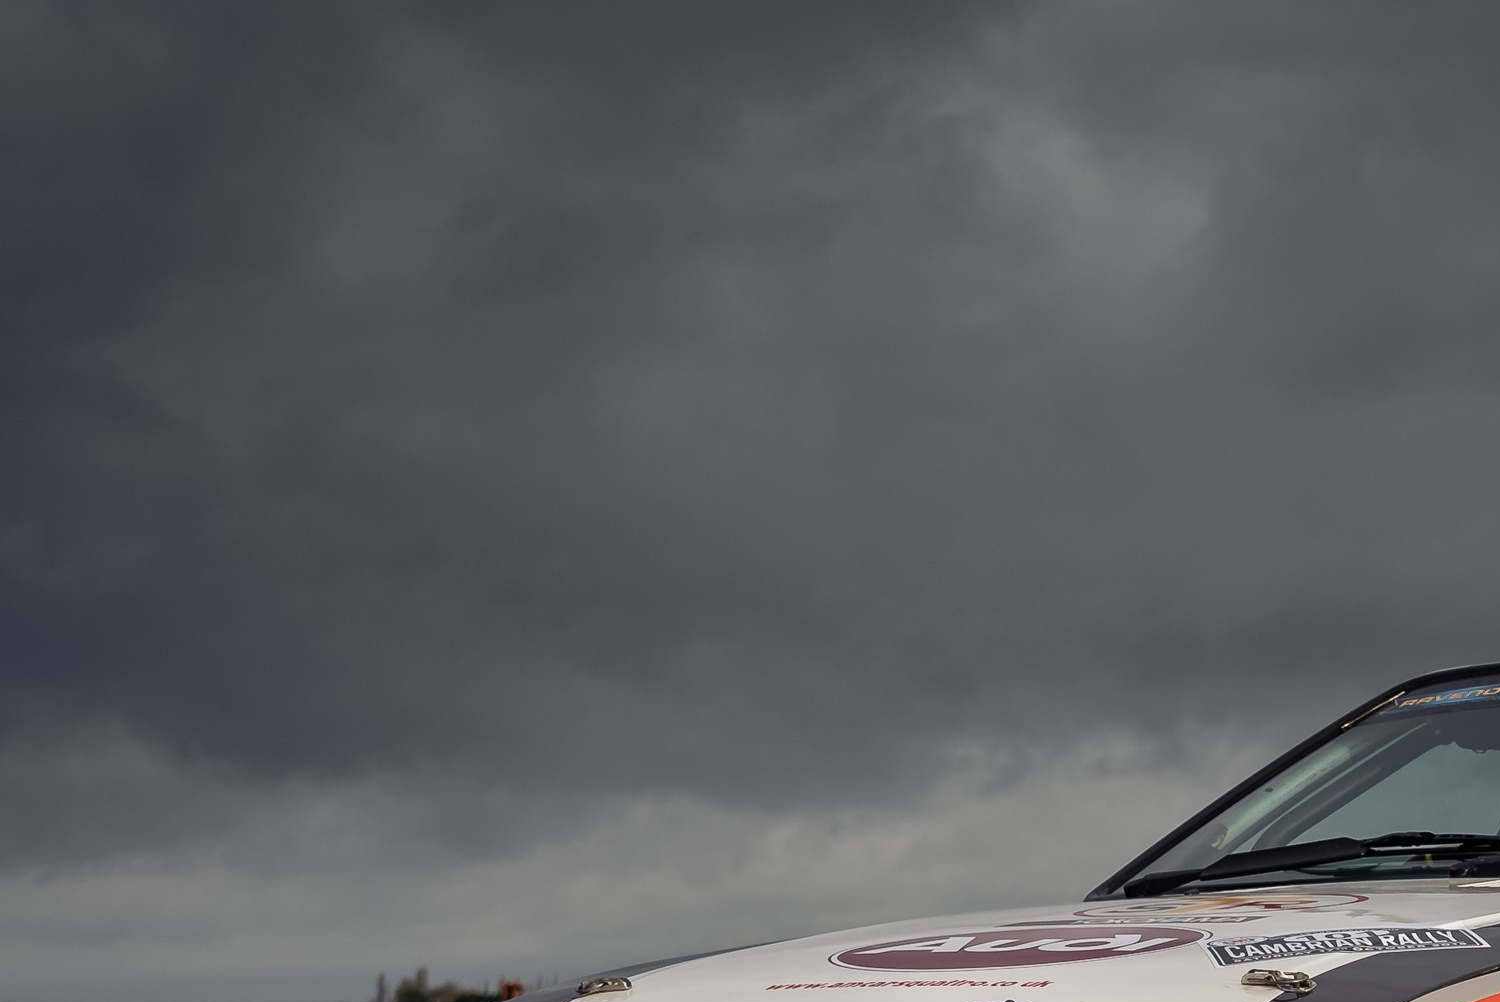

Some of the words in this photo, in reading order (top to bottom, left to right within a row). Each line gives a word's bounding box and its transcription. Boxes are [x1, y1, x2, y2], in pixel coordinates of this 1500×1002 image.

[854, 933, 1179, 955] Audi
[1224, 937, 1373, 959] CAMBRIAN
[1378, 931, 1458, 947] RALLY
